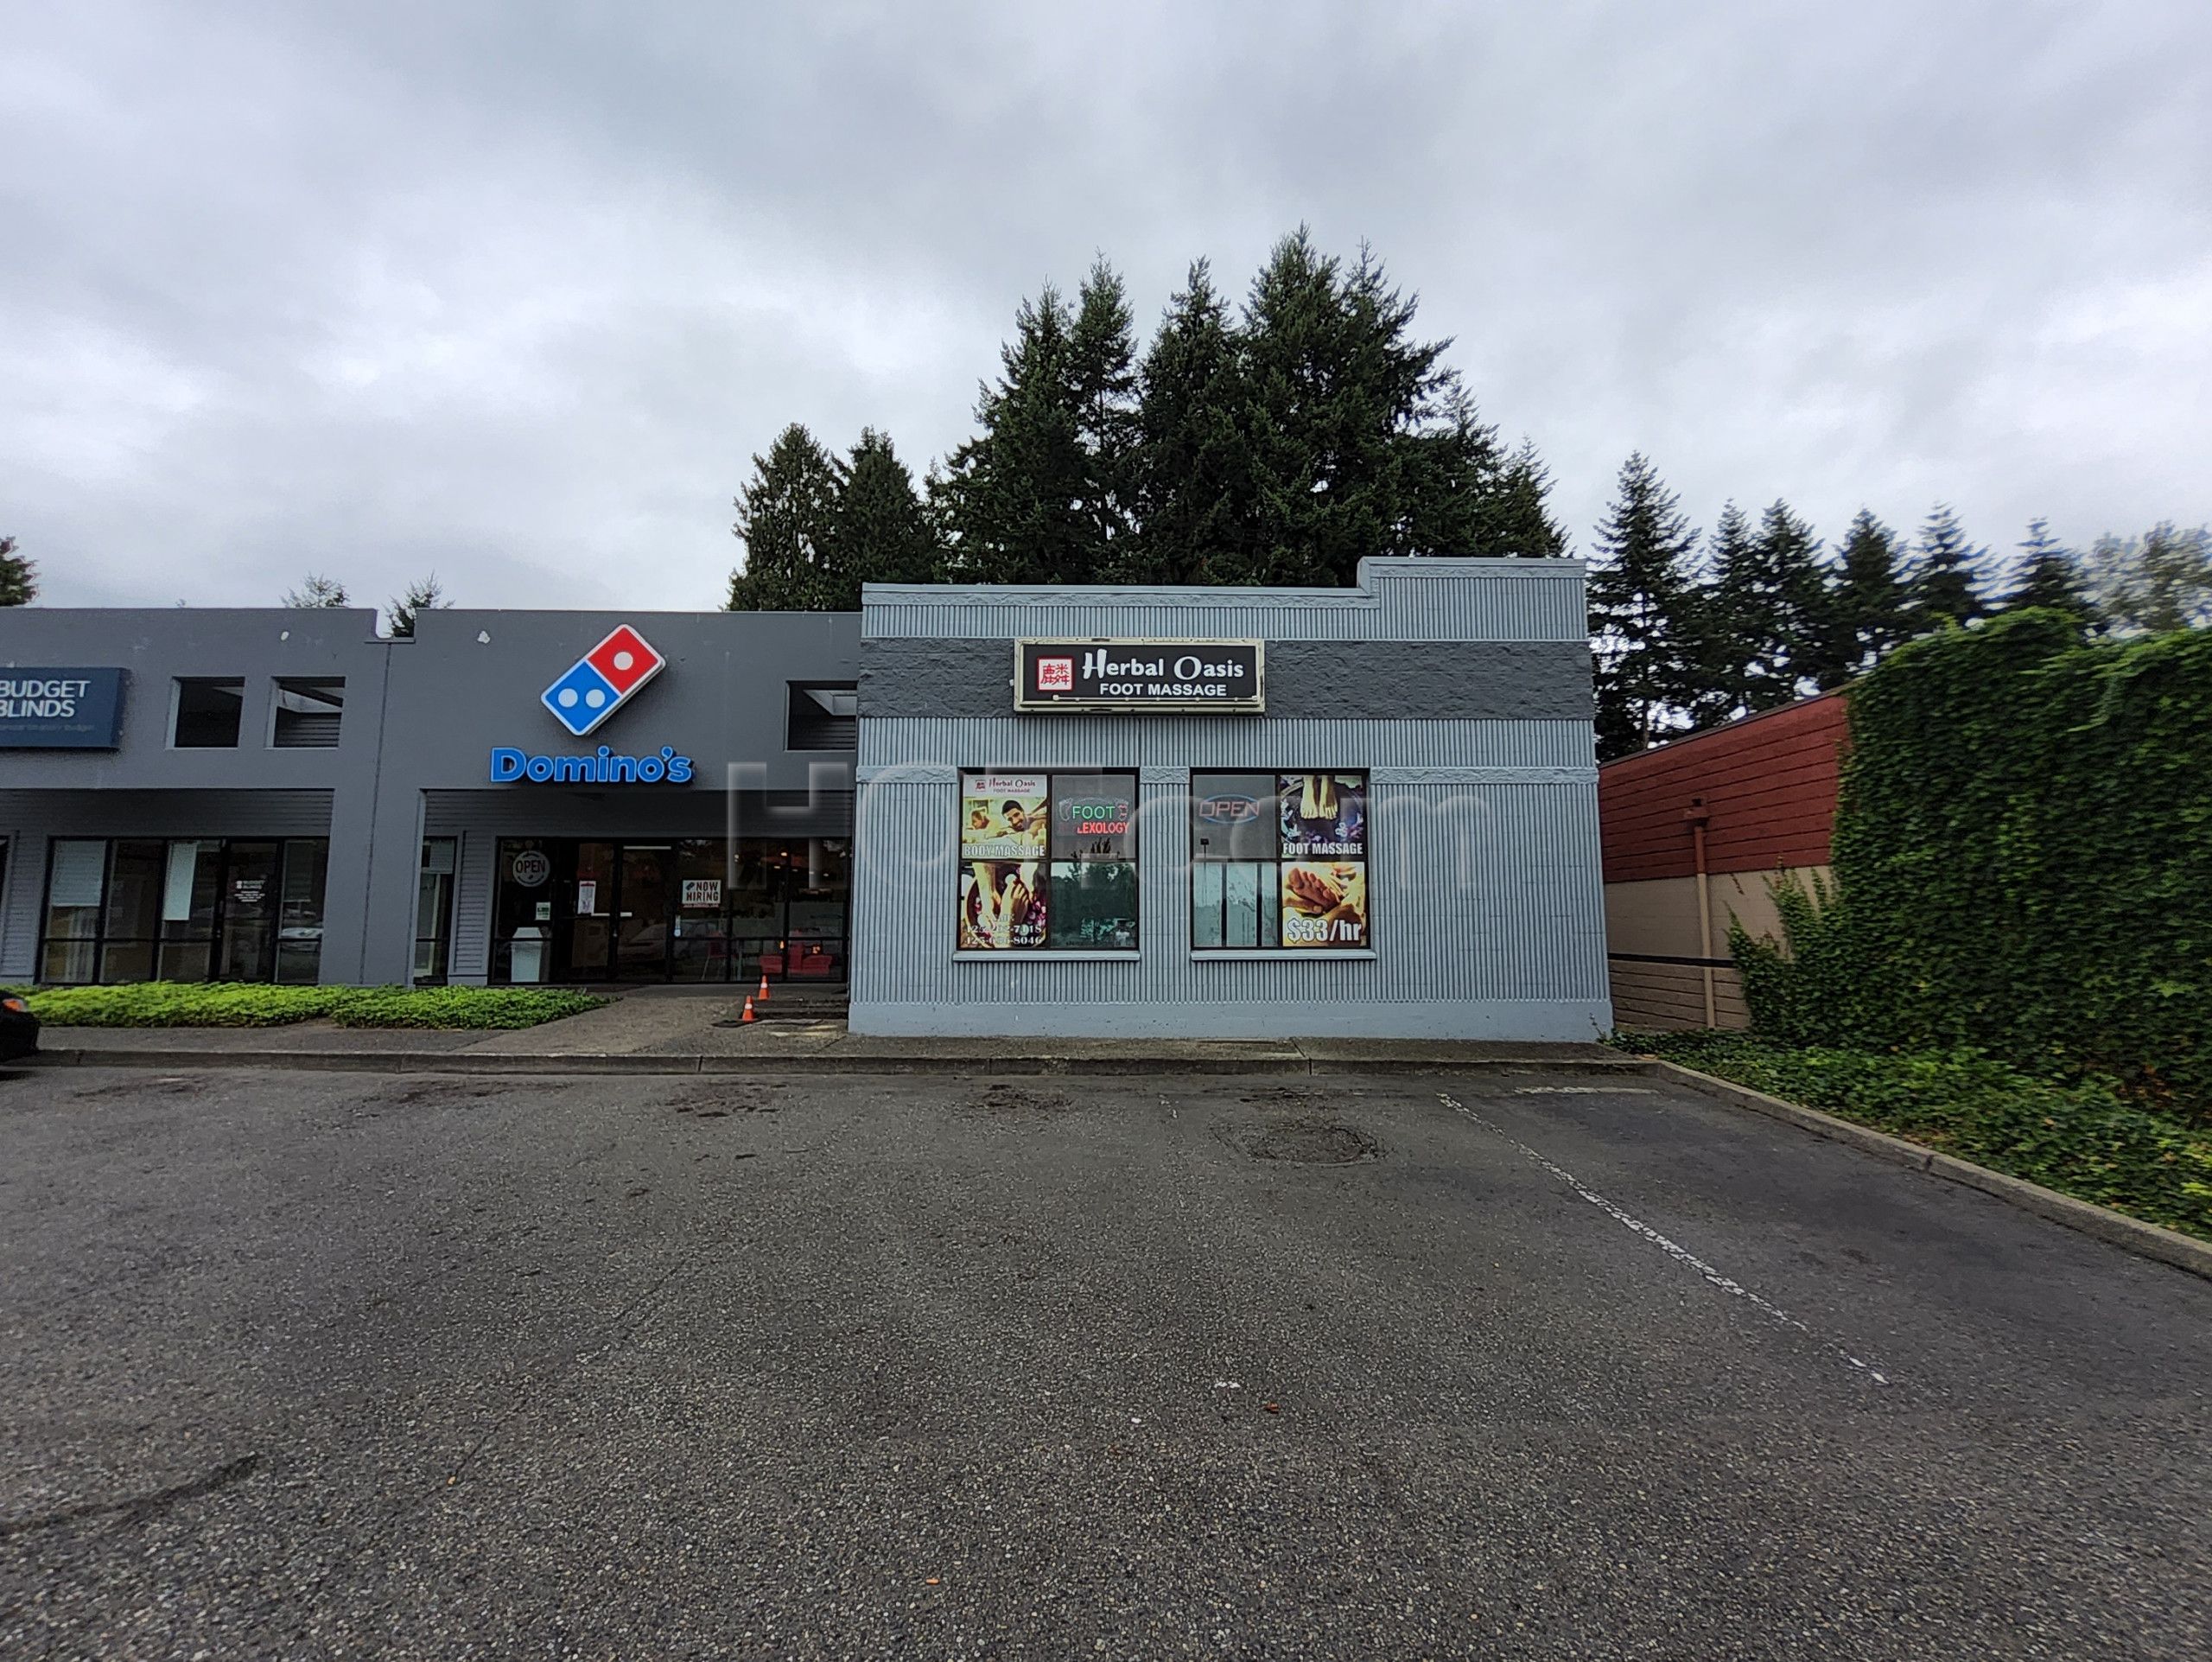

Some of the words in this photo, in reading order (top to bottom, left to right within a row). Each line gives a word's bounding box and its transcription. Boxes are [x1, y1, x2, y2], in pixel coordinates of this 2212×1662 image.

[1082, 648, 1165, 679] Herbal
[1173, 655, 1244, 681] Oasis
[0, 679, 92, 698] BUDGET
[1100, 683, 1143, 696] FOOT
[1147, 684, 1227, 697] MASSAGE
[490, 745, 695, 783] Domino's
[1015, 779, 1036, 788] Oasis
[1071, 806, 1116, 820] FOOT
[1199, 800, 1260, 817] OPEN
[963, 844, 992, 856] BODY
[995, 844, 1046, 857] MASSAGE
[1282, 842, 1310, 855] FOOT
[1312, 842, 1363, 855] MASSAGE
[515, 859, 547, 873] OPEN
[696, 881, 718, 891] NOW
[686, 891, 719, 901] HIRING
[1287, 917, 1363, 944] $33/hr
